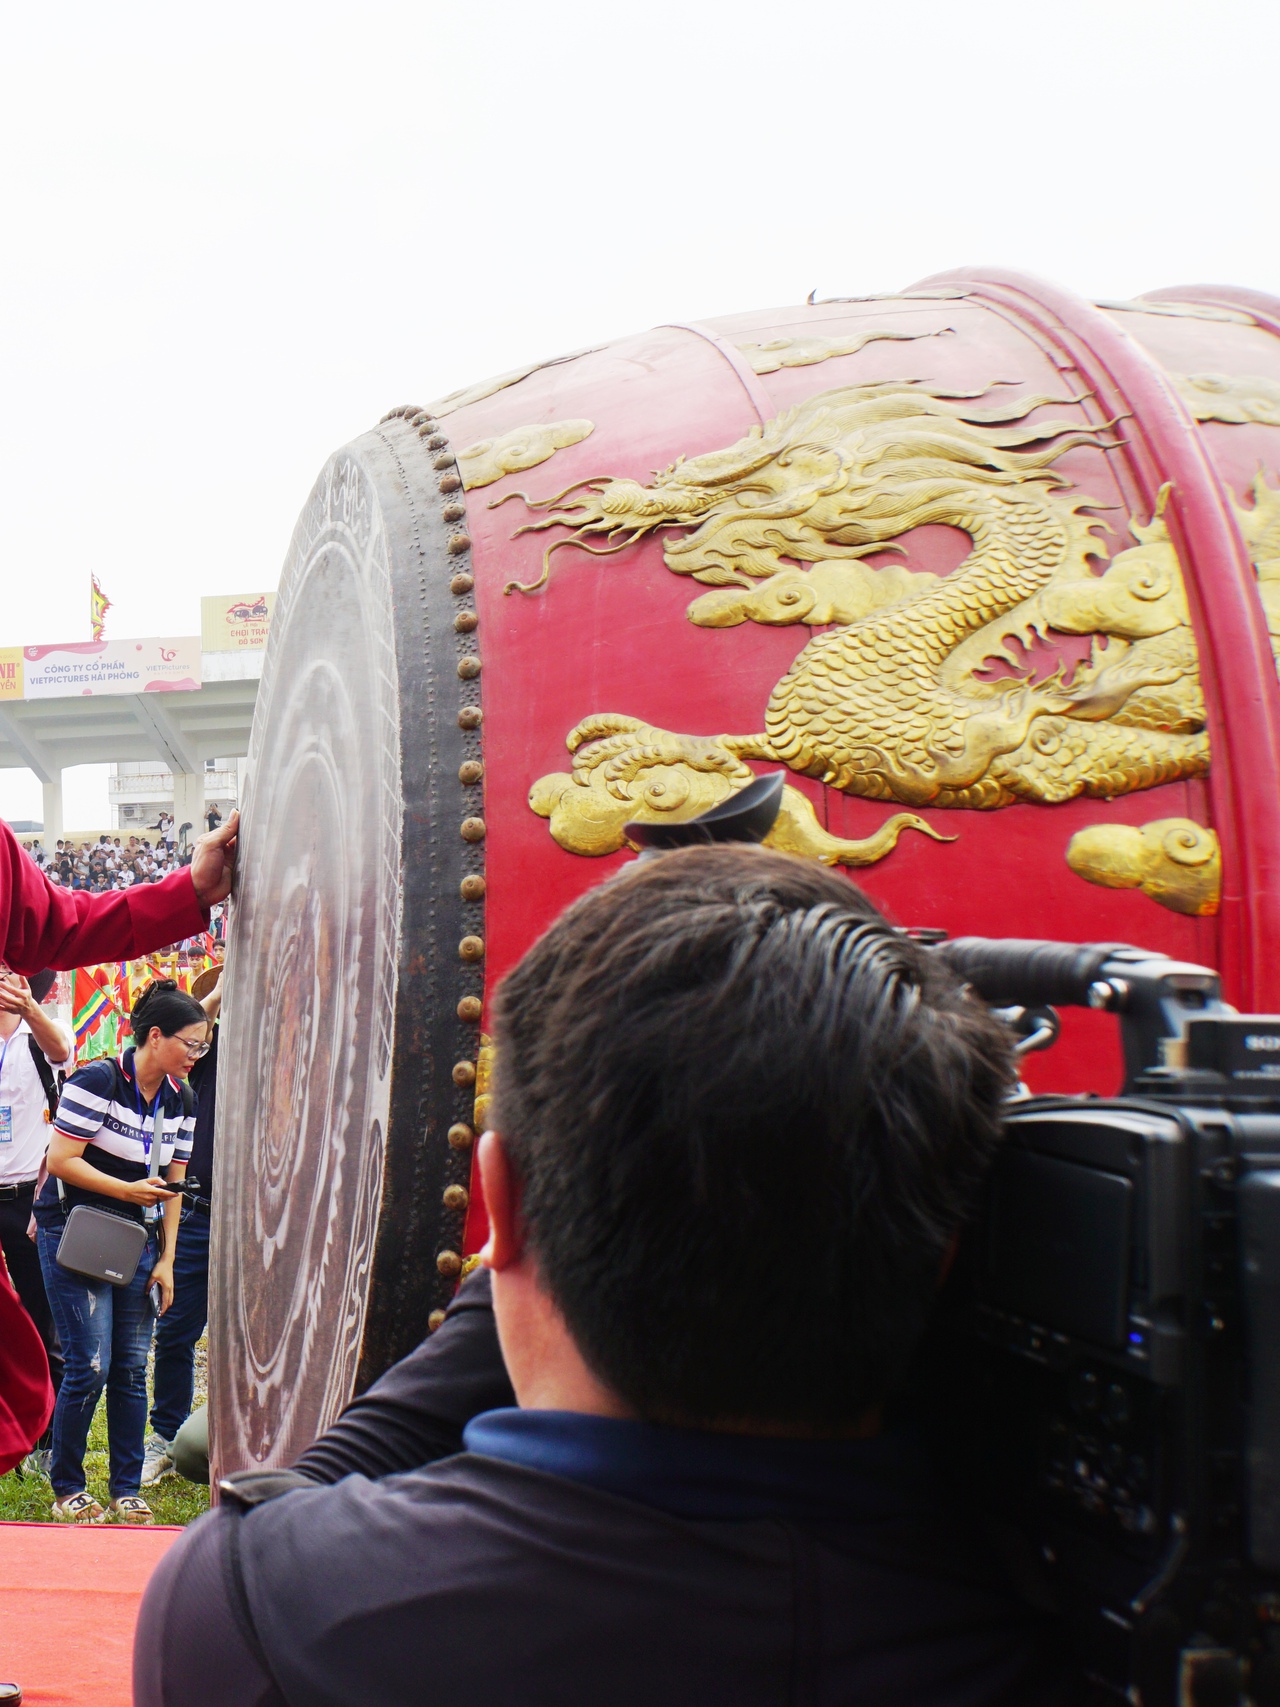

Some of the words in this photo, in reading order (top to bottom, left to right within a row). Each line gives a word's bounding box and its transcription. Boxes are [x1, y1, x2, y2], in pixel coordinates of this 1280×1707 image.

[44, 664, 71, 674] CÔNG
[29, 674, 89, 685] VIETPICTURES
[91, 671, 106, 681] HẢI
[108, 670, 140, 680] PHÒNG
